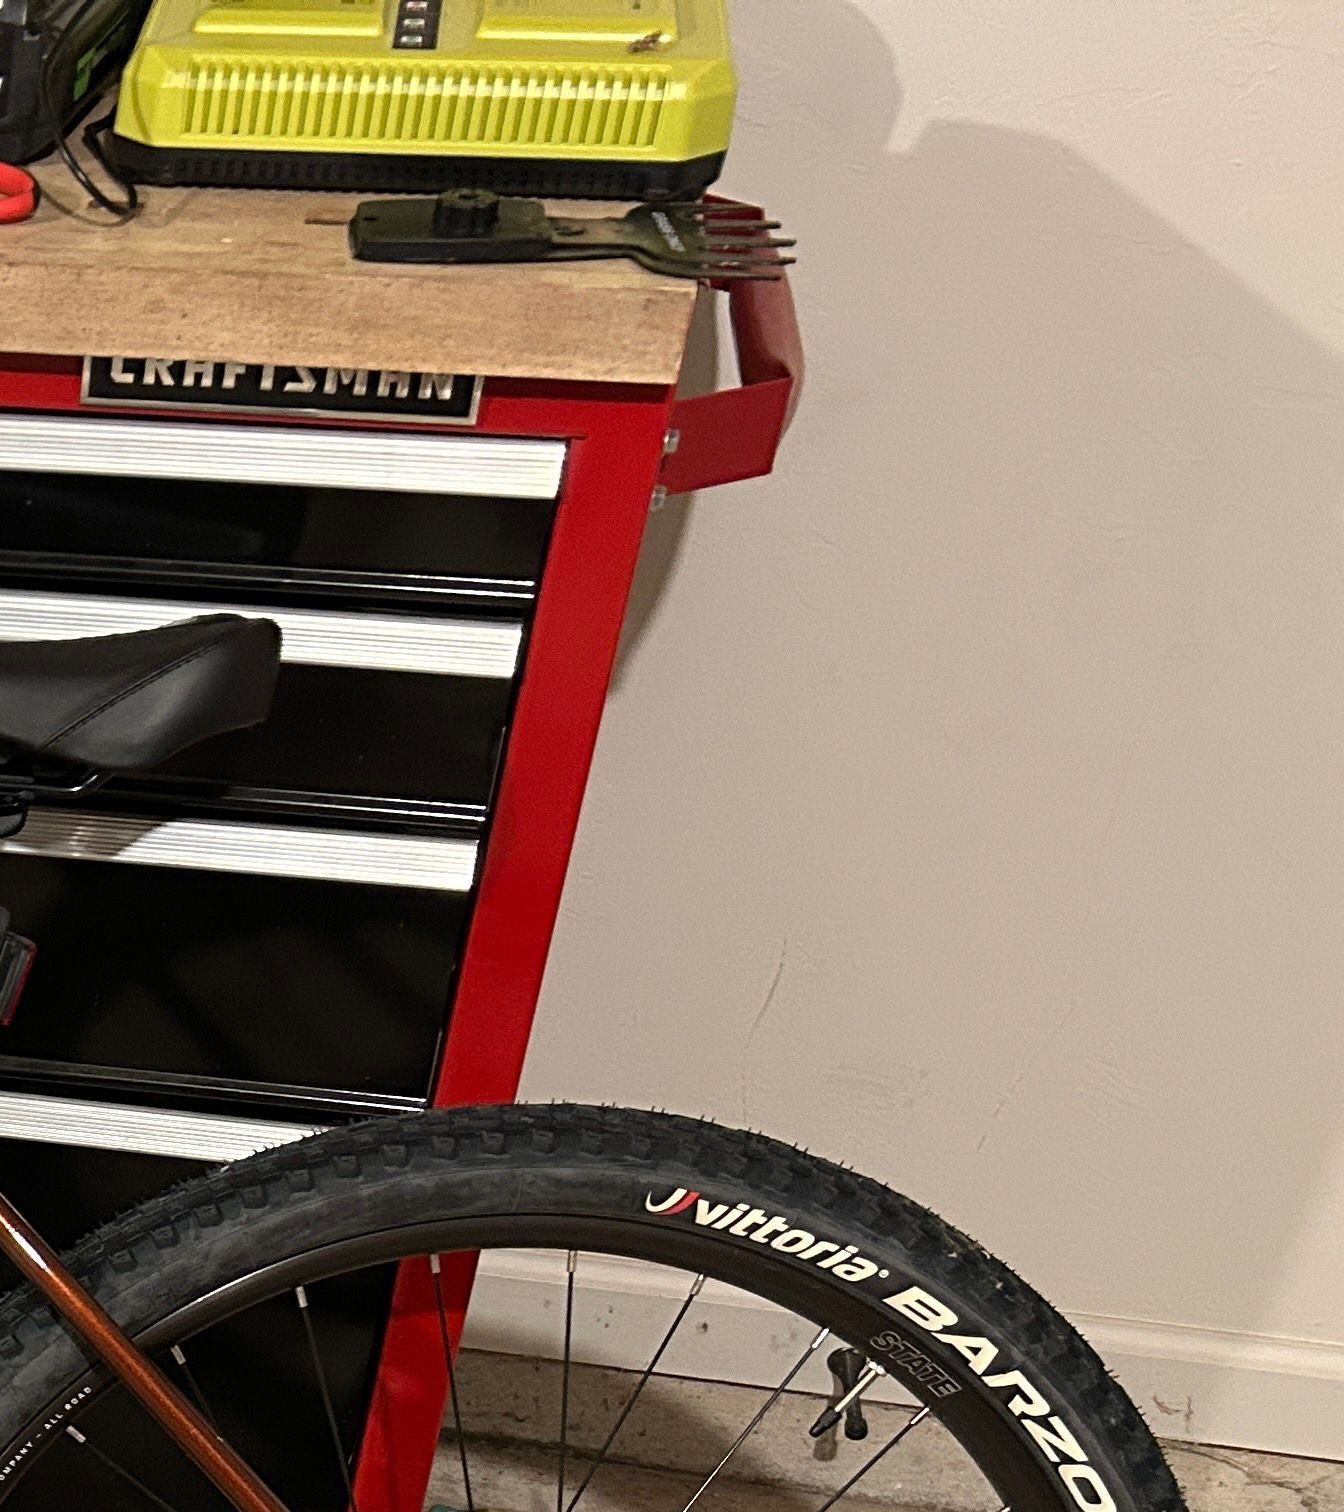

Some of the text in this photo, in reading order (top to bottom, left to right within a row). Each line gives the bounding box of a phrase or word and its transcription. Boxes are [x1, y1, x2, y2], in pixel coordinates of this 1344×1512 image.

[695, 1199, 879, 1283] vittoria
[868, 1331, 962, 1397] STATE
[43, 1413, 64, 1430] ALL
[64, 1386, 92, 1411] ROAD
